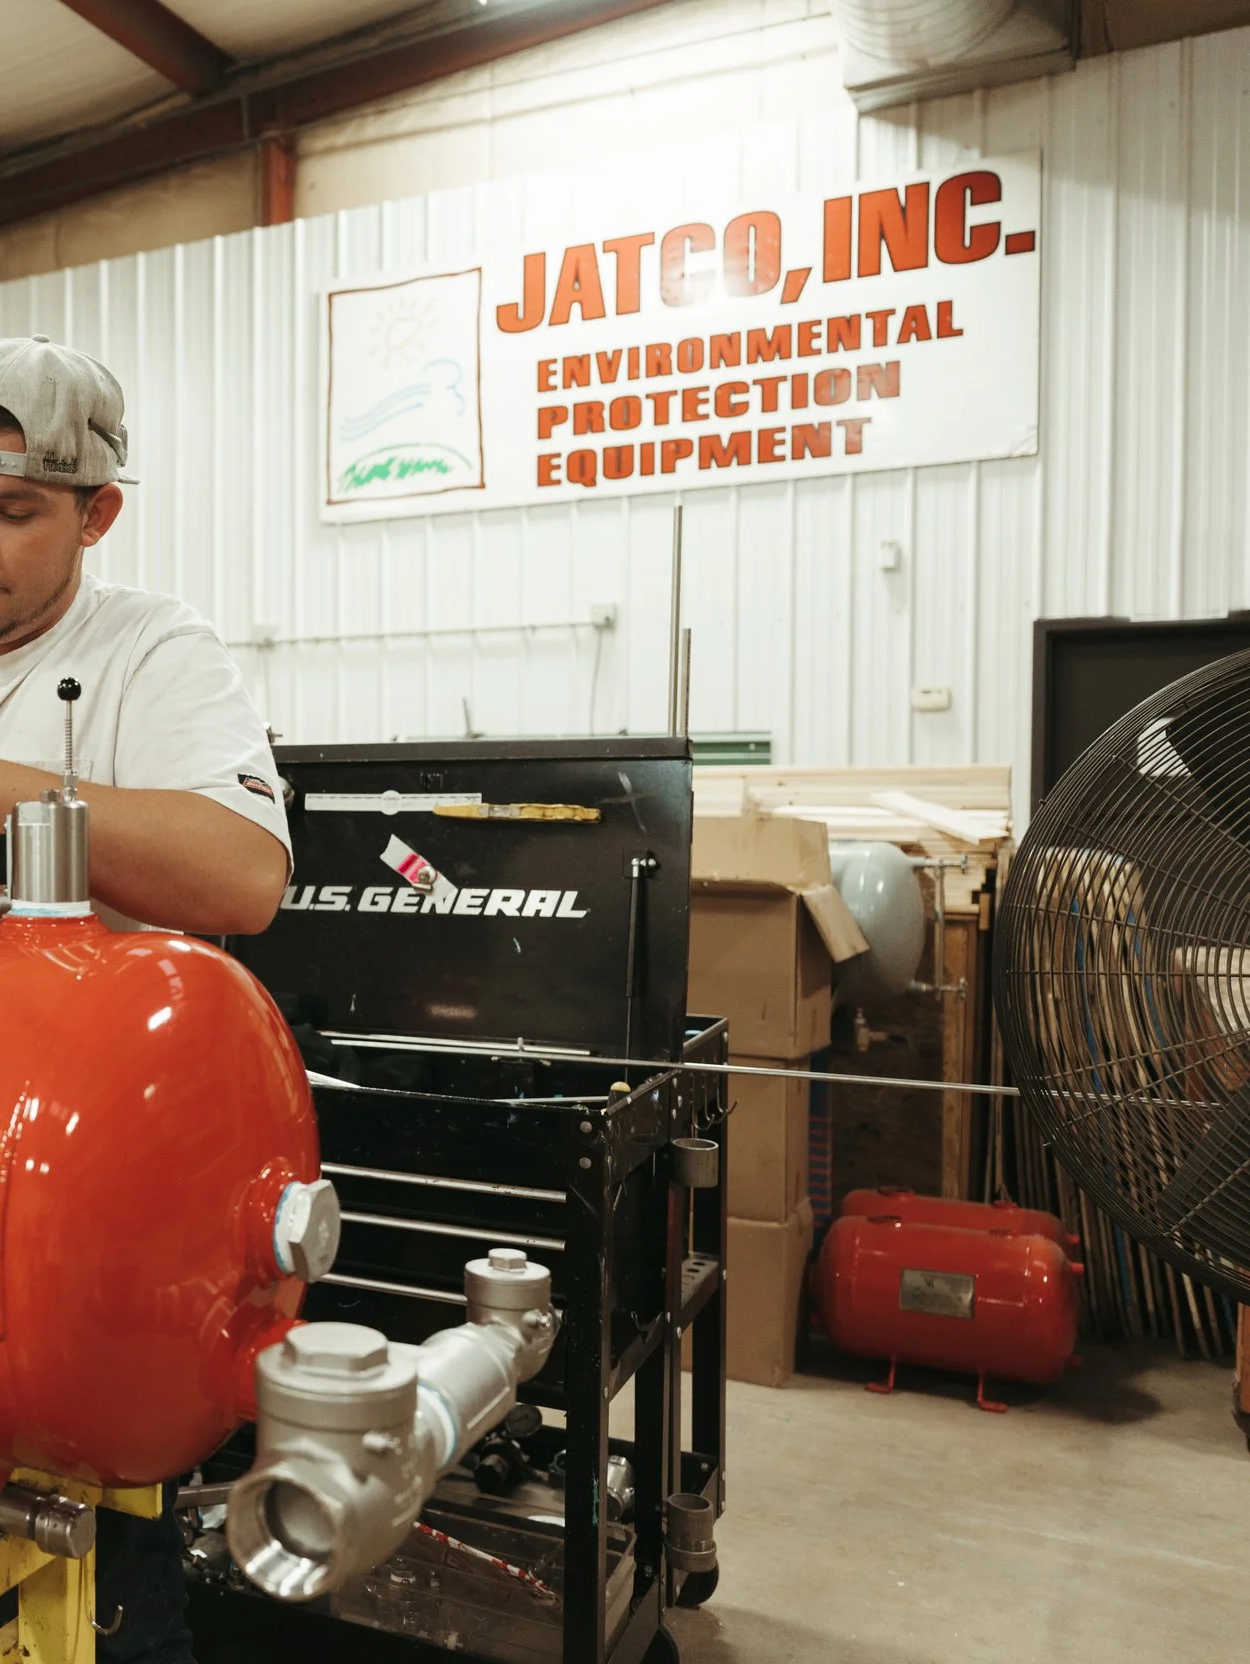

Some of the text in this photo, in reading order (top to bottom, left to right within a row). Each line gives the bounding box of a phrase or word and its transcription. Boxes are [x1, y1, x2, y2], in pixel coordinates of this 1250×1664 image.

[496, 170, 1036, 333] JATCO, INC.
[537, 300, 963, 392] ENVIRONMENTAL
[537, 360, 900, 439] PROTECTION
[537, 417, 872, 487] EQUIPMENT
[280, 885, 587, 918] U.S. GENERAL
